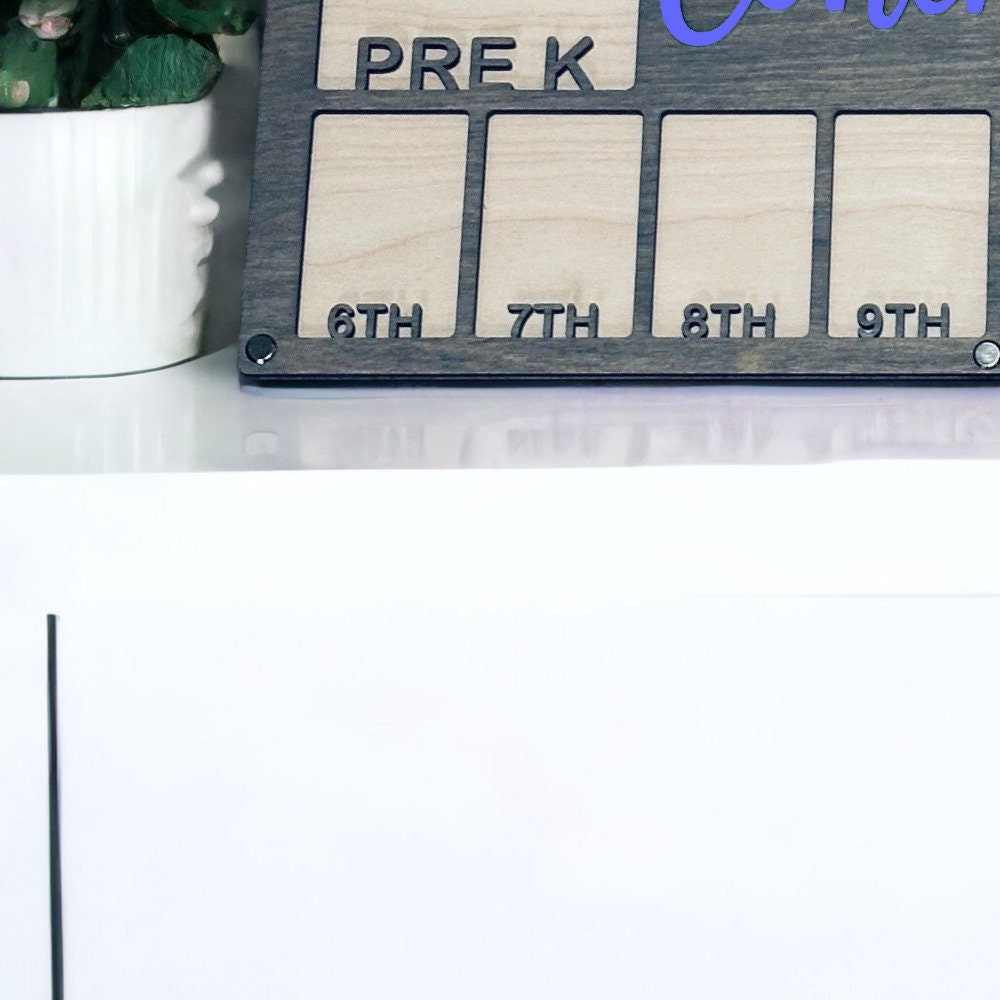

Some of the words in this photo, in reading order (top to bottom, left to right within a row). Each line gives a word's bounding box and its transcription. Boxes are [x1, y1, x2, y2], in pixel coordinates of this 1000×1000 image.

[355, 35, 517, 91] PRE
[544, 35, 596, 91] K
[326, 302, 423, 339] 6TH
[506, 302, 599, 339] 7TH
[680, 302, 776, 339] 8TH
[856, 302, 951, 339] 9TH
